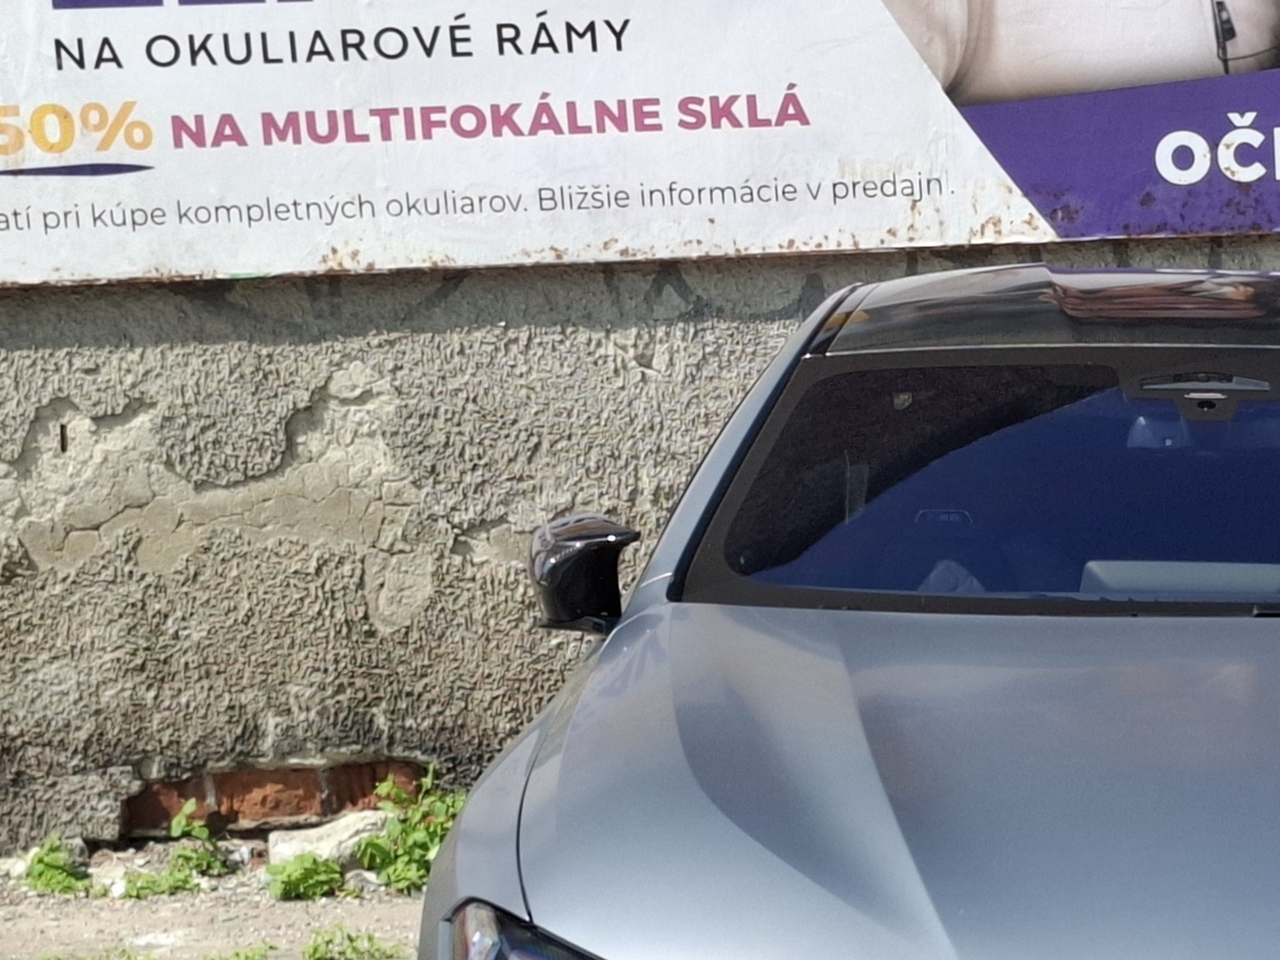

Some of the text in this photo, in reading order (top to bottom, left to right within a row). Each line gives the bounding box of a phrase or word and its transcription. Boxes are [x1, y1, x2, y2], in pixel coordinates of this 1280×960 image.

[54, 9, 631, 71] NA OKULIAROVÉ RÁMY
[171, 113, 248, 149] NA
[261, 92, 663, 146] MULTIFOKÁLNE
[678, 82, 811, 130] SKLÁ
[42, 203, 80, 235] pri
[91, 202, 166, 232] kúpe
[177, 194, 375, 228] kompletných
[386, 190, 527, 217] okuliarov.
[538, 184, 630, 211] Bližšie
[640, 177, 797, 207] informácie
[806, 182, 821, 200] v
